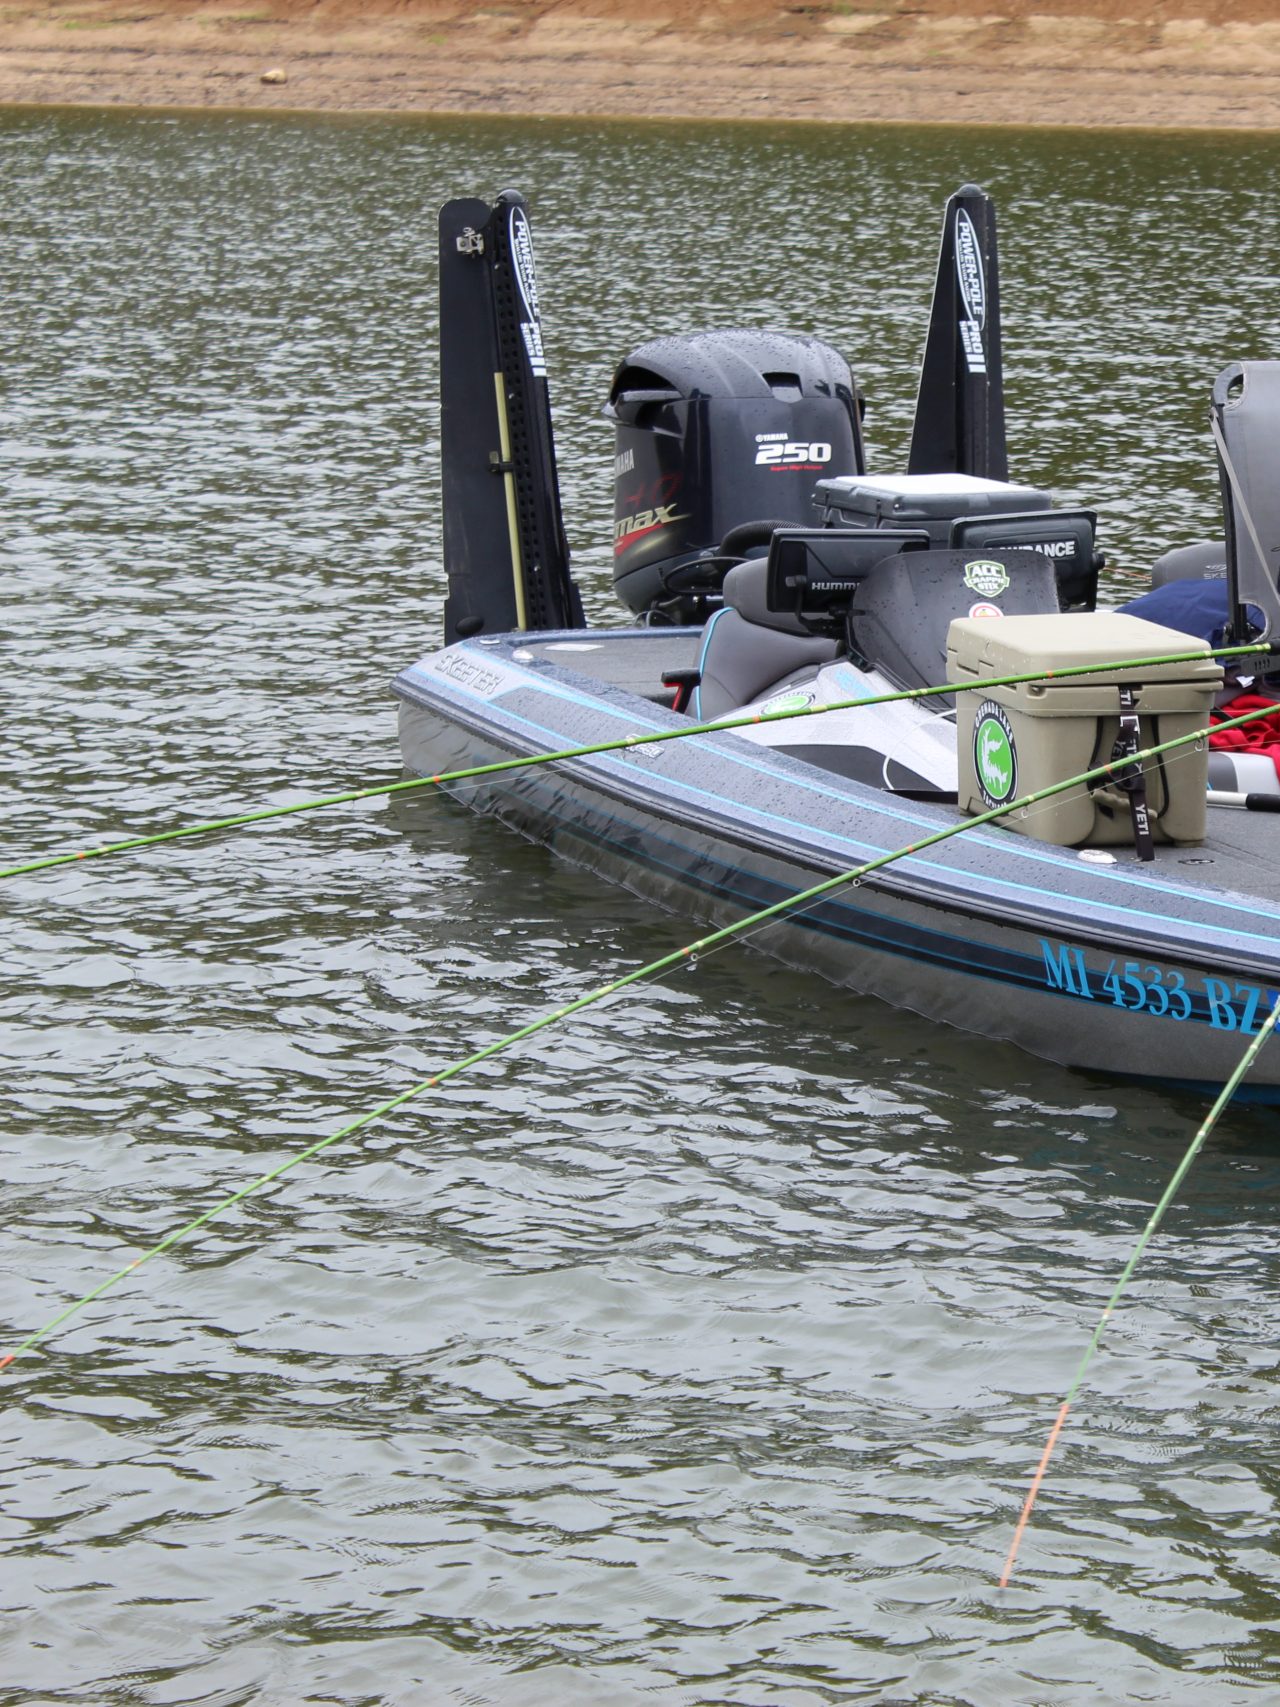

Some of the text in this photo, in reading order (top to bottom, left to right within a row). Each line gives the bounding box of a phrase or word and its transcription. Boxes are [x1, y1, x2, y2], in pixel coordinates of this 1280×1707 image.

[515, 221, 540, 317] POWER-POLE
[959, 222, 984, 315] POWER-POLE
[520, 322, 536, 357] SERIES
[529, 322, 543, 357] PRO
[959, 320, 973, 353] SERIES
[967, 320, 985, 354] PRO
[755, 442, 832, 465] 250
[762, 433, 789, 442] YAMAHA
[971, 564, 1002, 577] ACC
[977, 582, 1001, 591] STIX
[435, 655, 506, 695] SKEETER
[1135, 803, 1150, 837] YETI
[1039, 938, 1263, 1037] MI 4533 BZ
